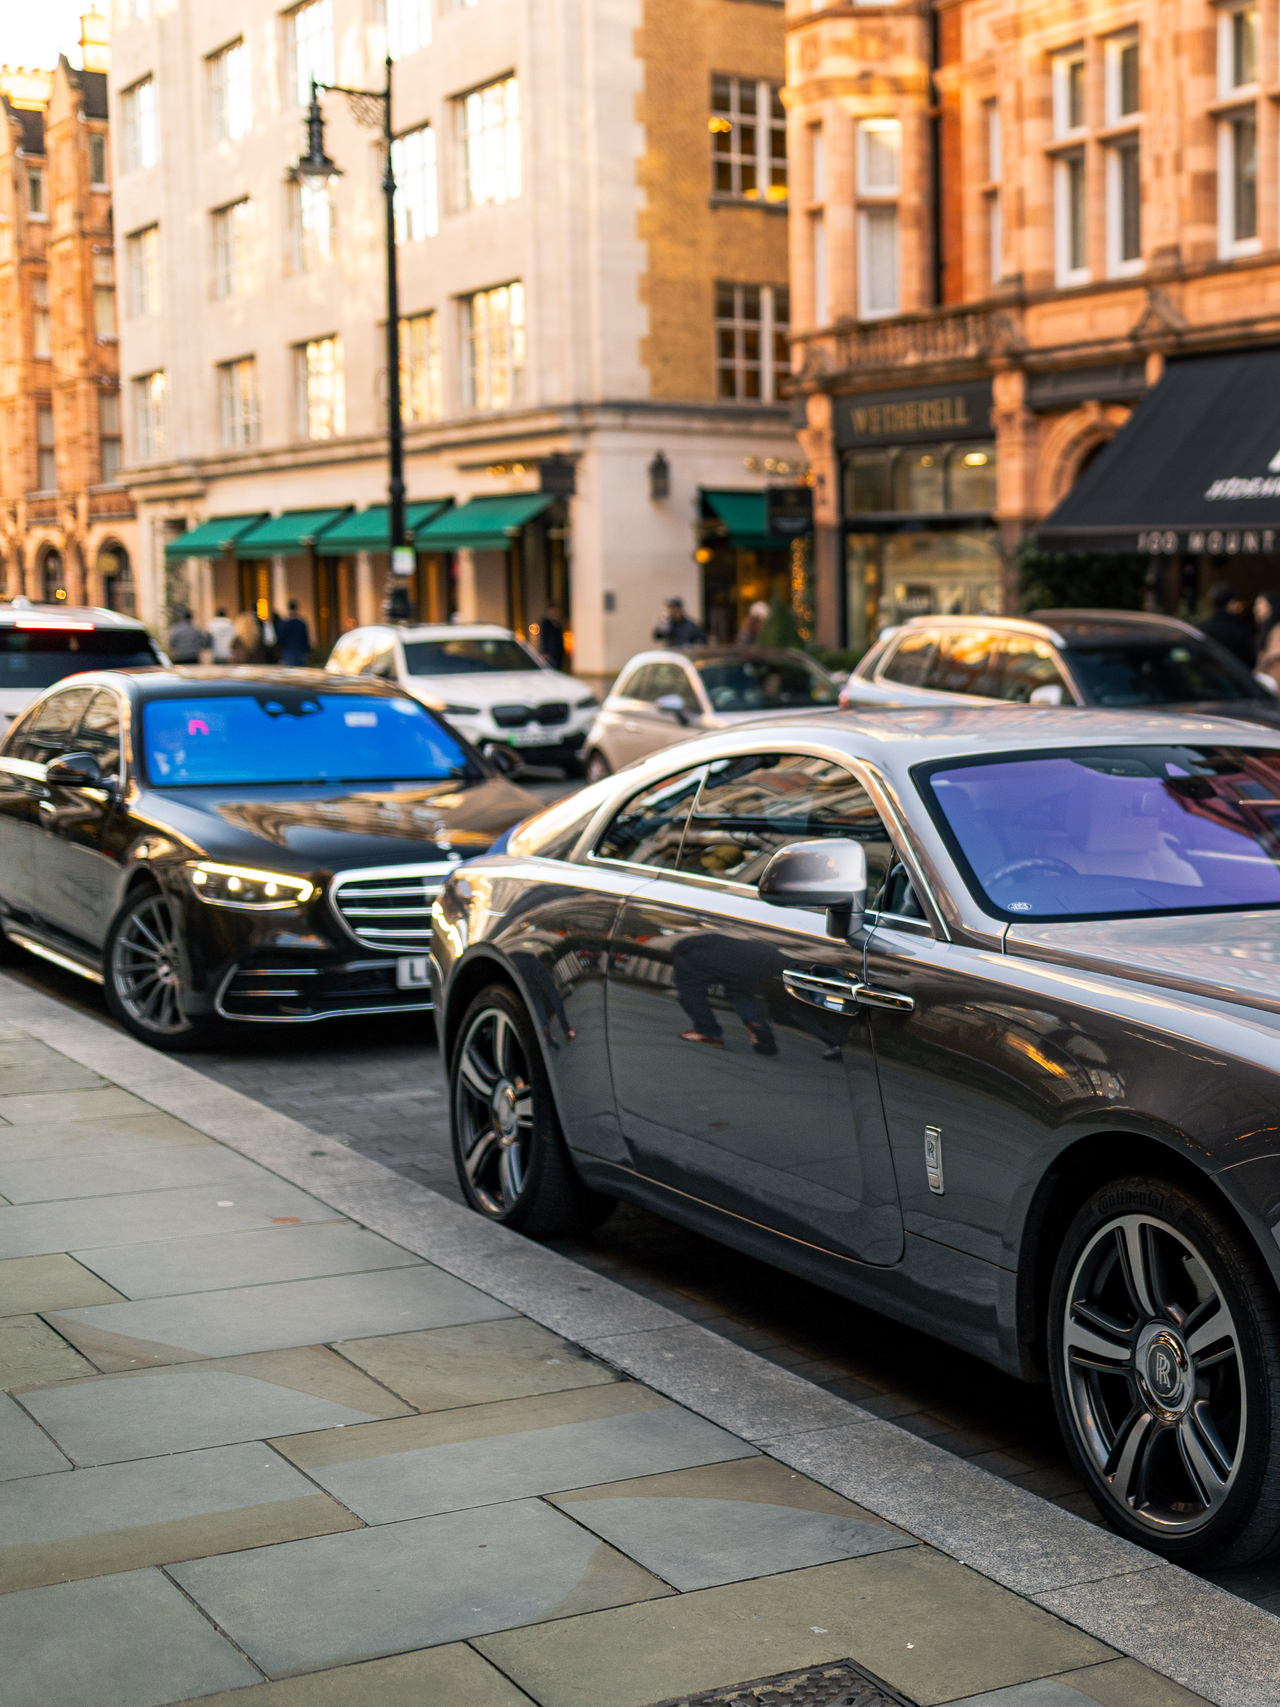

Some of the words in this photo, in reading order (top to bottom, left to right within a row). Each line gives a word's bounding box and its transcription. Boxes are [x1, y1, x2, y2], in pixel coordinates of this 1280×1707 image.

[850, 397, 970, 434] WETHERELL
[1138, 531, 1178, 554] 100
[1188, 530, 1275, 554] MOUNT
